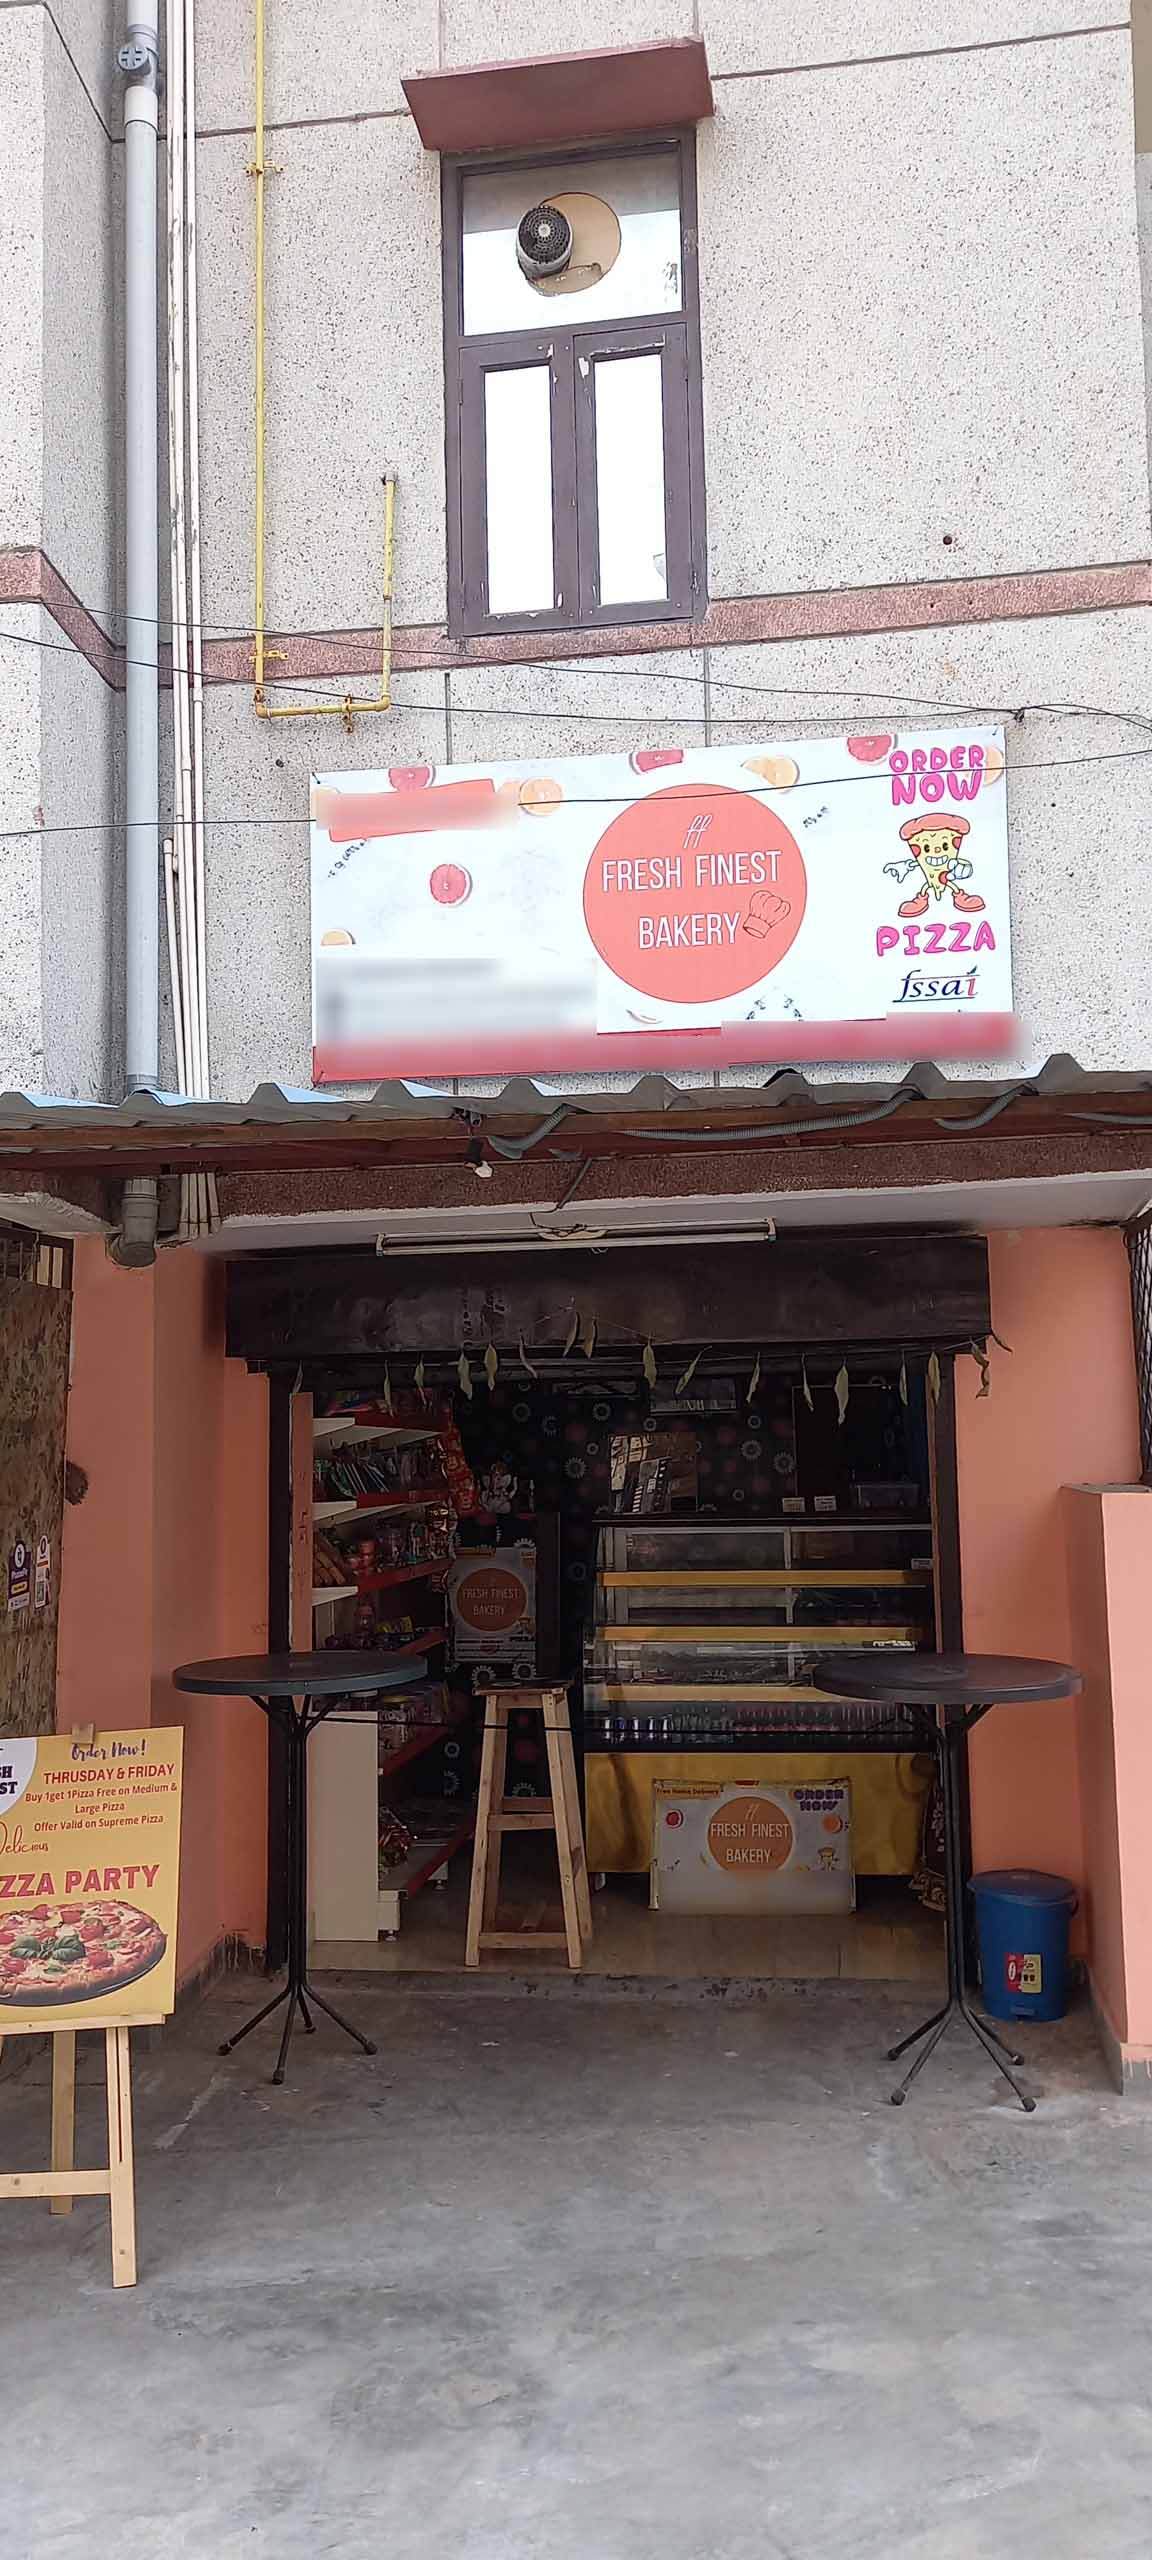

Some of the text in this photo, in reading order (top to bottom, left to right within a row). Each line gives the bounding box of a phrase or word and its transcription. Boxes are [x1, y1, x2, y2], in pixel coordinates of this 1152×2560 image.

[889, 744, 985, 773] ORDER
[891, 770, 983, 806] NOW
[601, 850, 782, 893] FRESH FINEST
[638, 911, 741, 949] BAKERY
[876, 920, 996, 957] PIZZA
[896, 965, 979, 1002] fssai
[71, 1738, 146, 1762] Order Now!
[43, 1763, 175, 1785] THRUSDAY & FRIDAY
[25, 1792, 42, 1804] Buy
[96, 1787, 116, 1798] Free
[118, 1787, 130, 1796] on
[131, 1783, 169, 1795] Medium
[170, 1781, 178, 1792] &
[75, 1802, 125, 1816] Large Pizza
[34, 1822, 58, 1832] Offer
[85, 1820, 97, 1829] on
[98, 1816, 139, 1830] Supreme
[141, 1814, 164, 1825] Pizza
[710, 1822, 789, 1838] FRESH FINEST
[726, 1848, 771, 1864] BAKERY
[65, 1863, 160, 1894] PARTY
